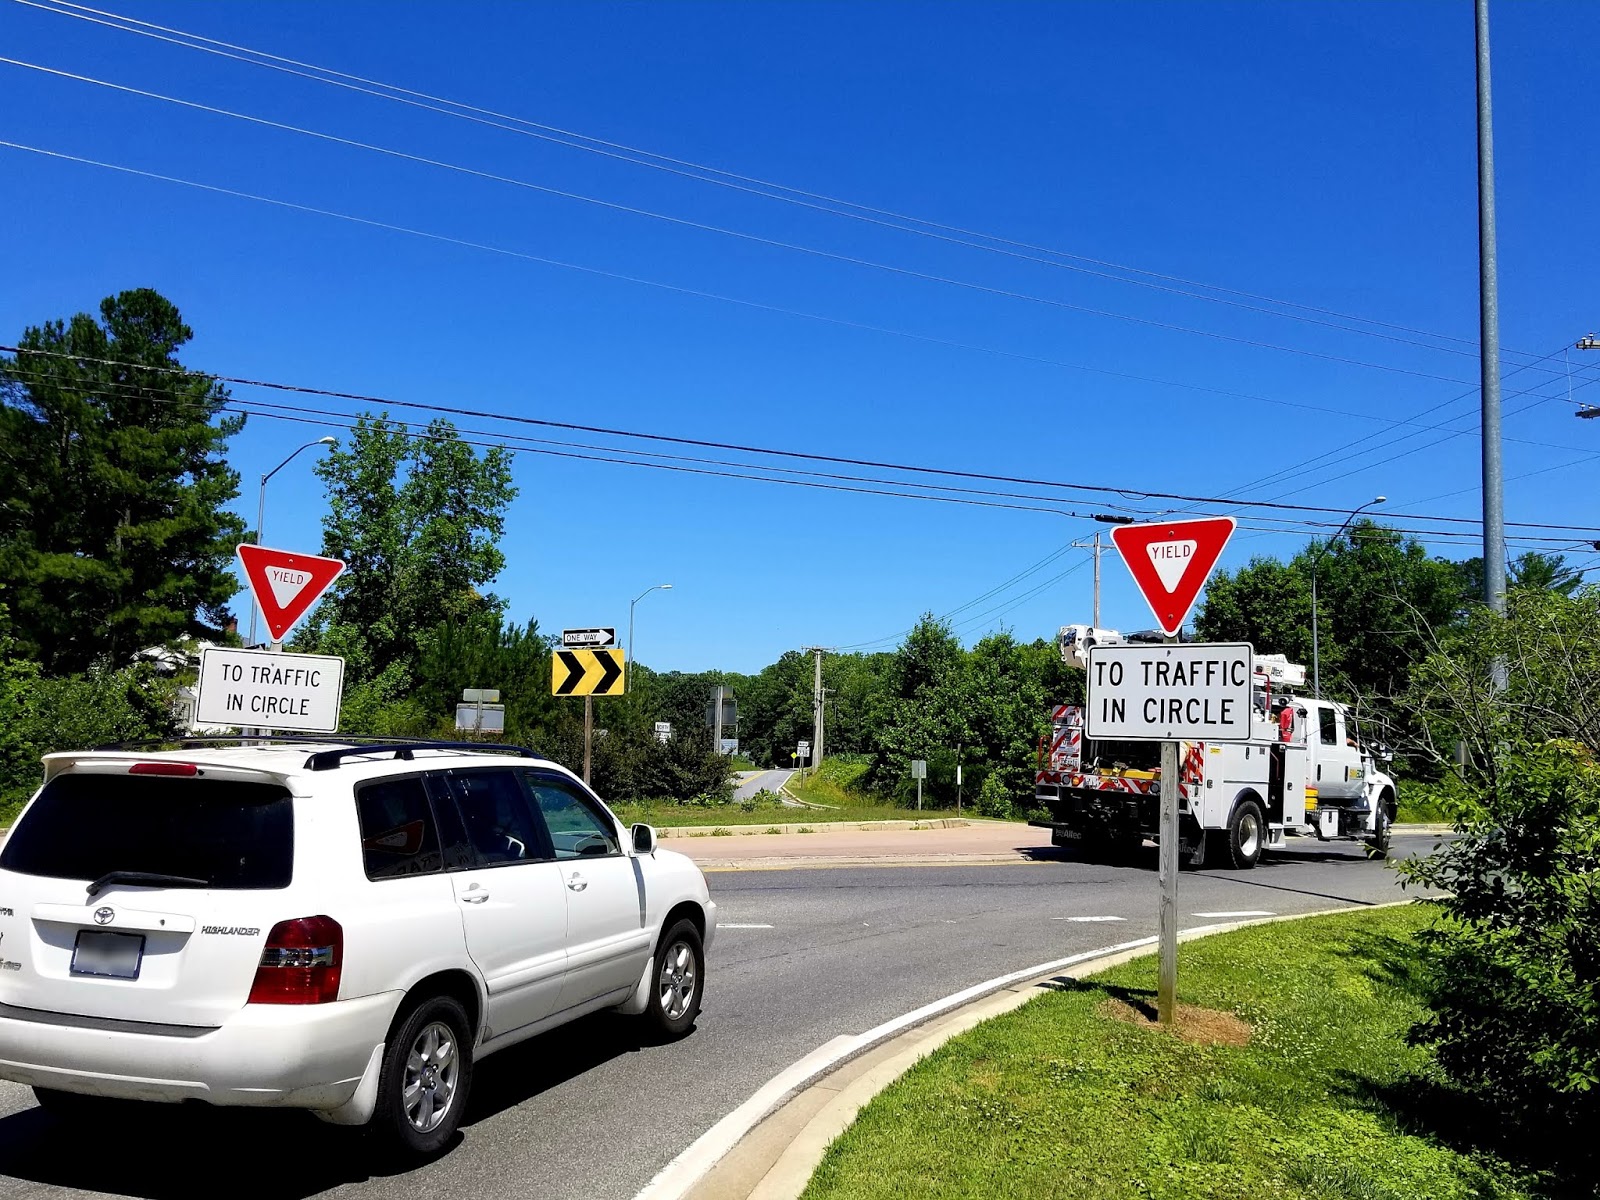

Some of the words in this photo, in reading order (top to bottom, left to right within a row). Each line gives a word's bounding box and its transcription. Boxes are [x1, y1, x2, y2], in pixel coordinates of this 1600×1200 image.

[1152, 545, 1191, 560] YIELD
[273, 570, 304, 585] YIELD
[566, 634, 581, 642] ONE
[583, 633, 598, 641] WAY
[222, 663, 243, 682] TO
[251, 666, 321, 688] TRAFFIC
[1095, 661, 1124, 687] TO
[1141, 660, 1246, 687] TRAFFIC
[226, 693, 244, 711] IN
[251, 695, 310, 716] CIRCLE
[1102, 698, 1126, 723] IN
[1143, 697, 1235, 725] CIRCLE
[201, 925, 261, 936] HIGHLANDER
